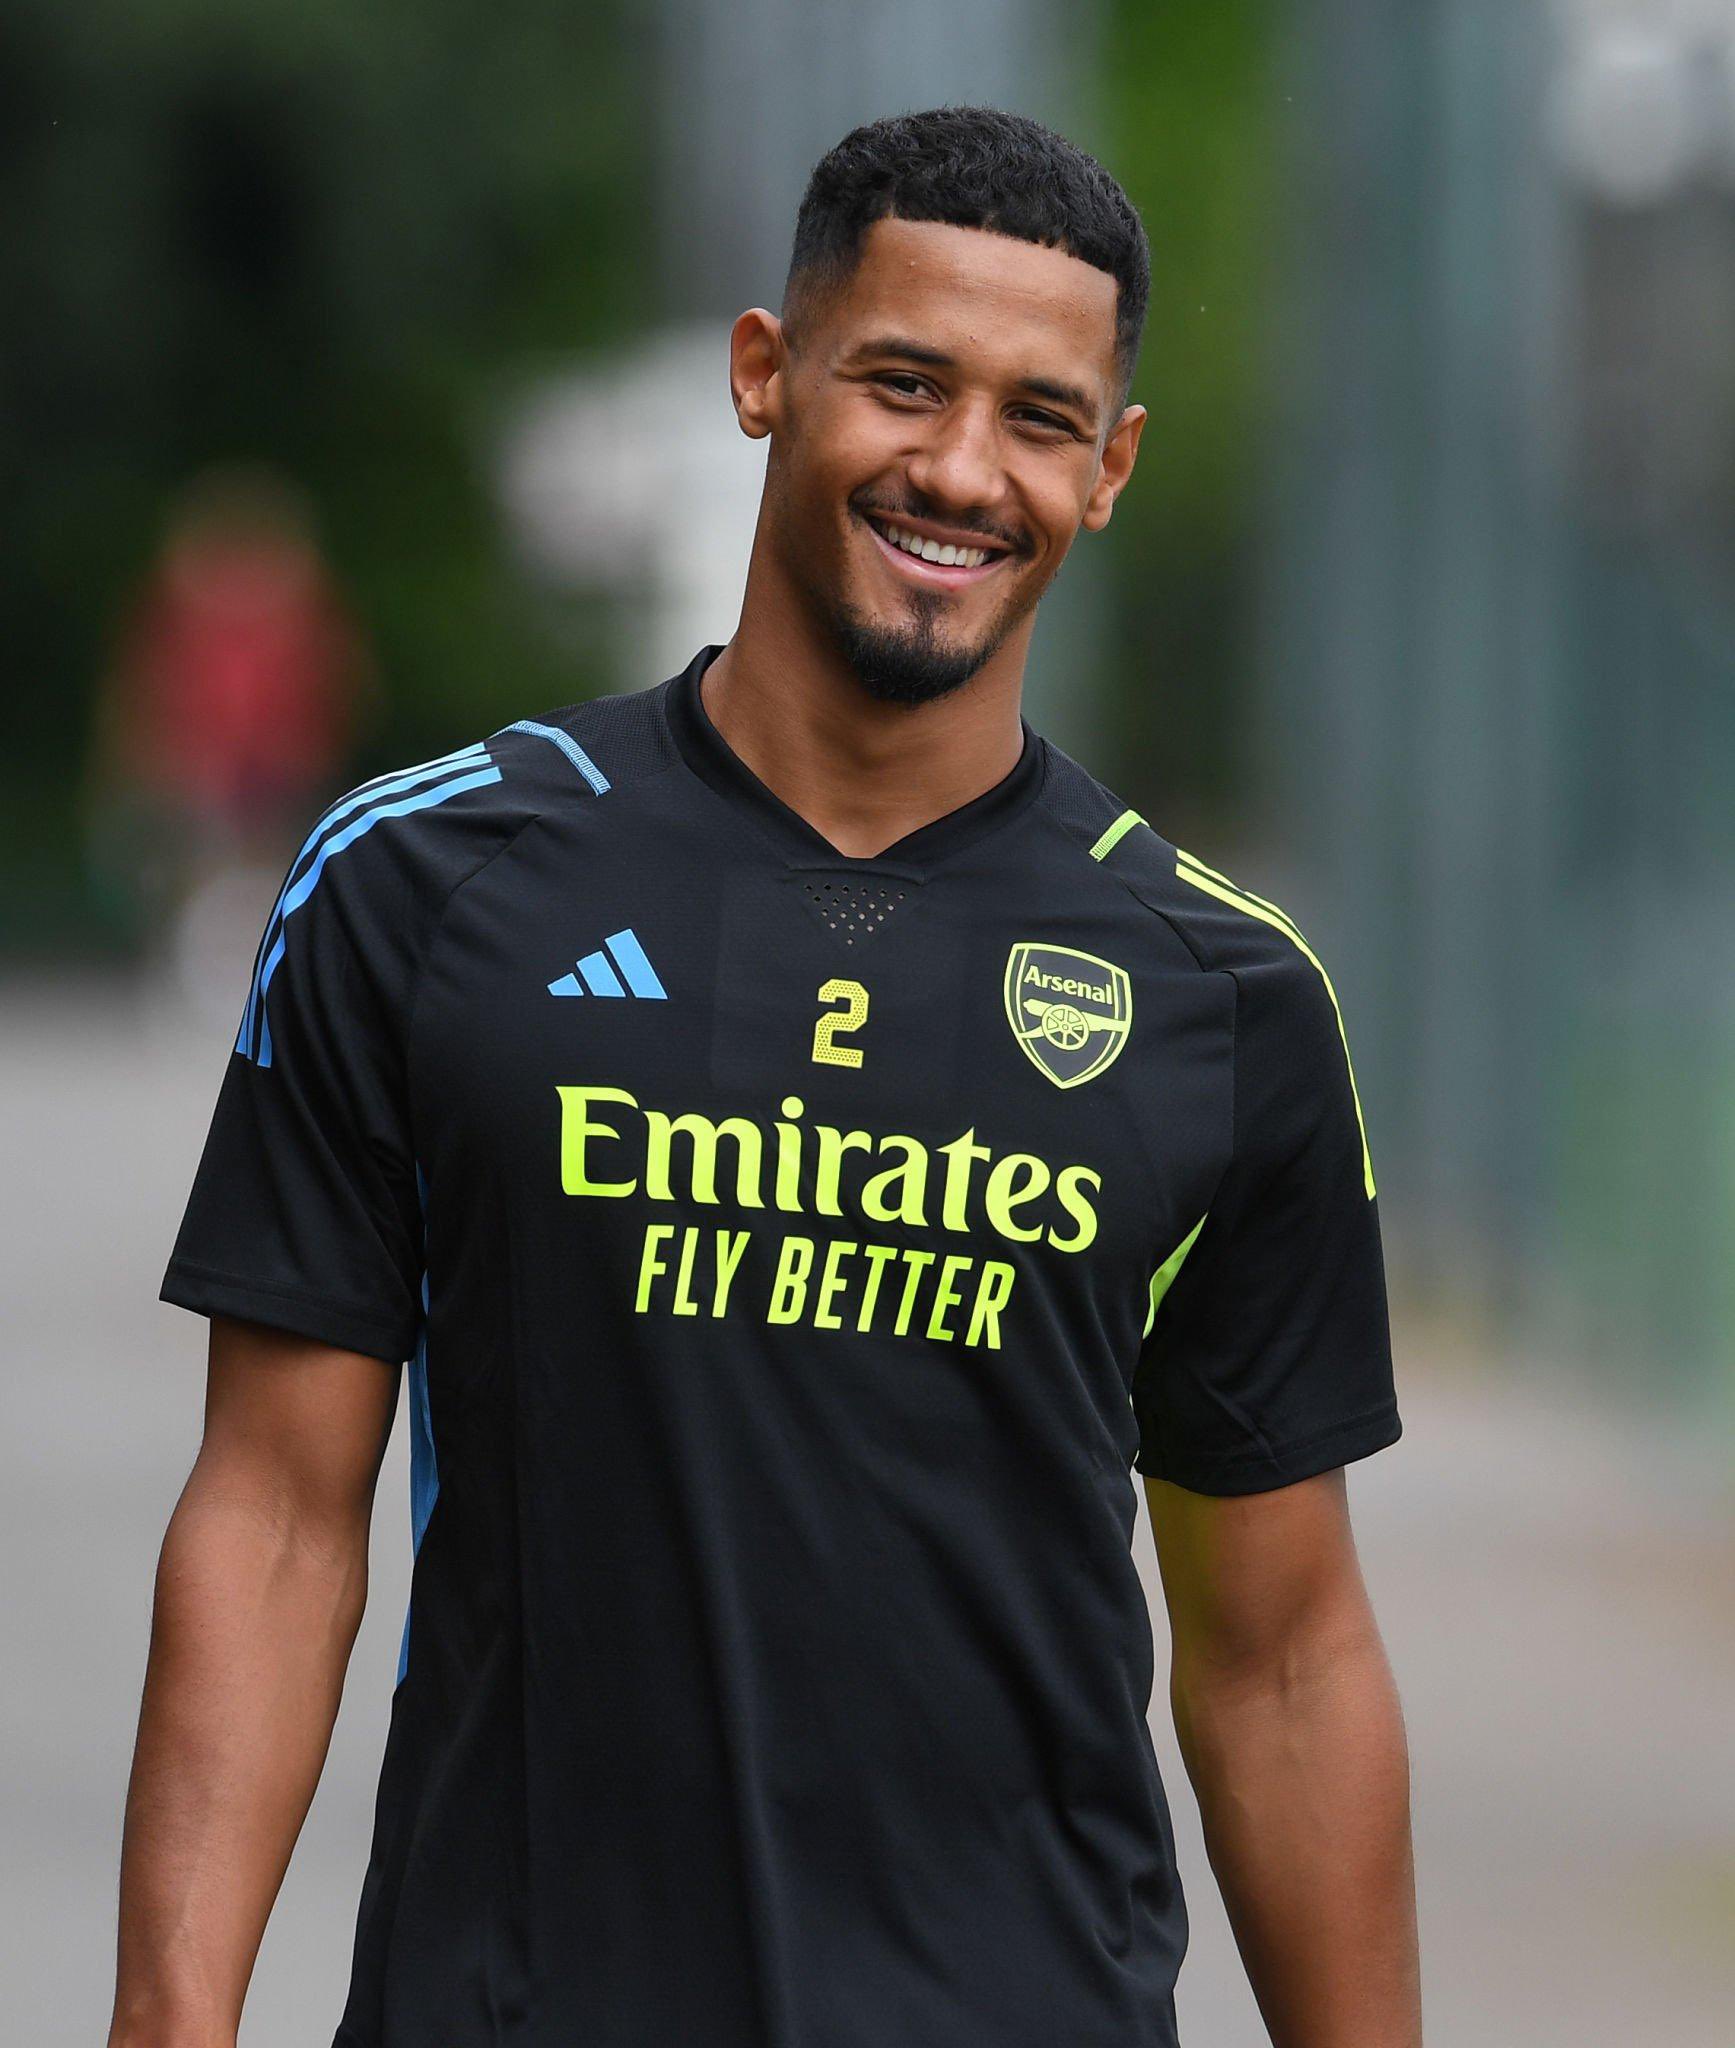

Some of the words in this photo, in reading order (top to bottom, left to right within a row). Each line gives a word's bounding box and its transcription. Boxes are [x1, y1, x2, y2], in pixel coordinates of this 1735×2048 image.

[811, 978, 869, 1068] 2
[1023, 965, 1113, 1005] Arsenal
[555, 1085, 1101, 1253] Emirates
[635, 1224, 751, 1319] FLY
[767, 1236, 1016, 1349] BETTER
